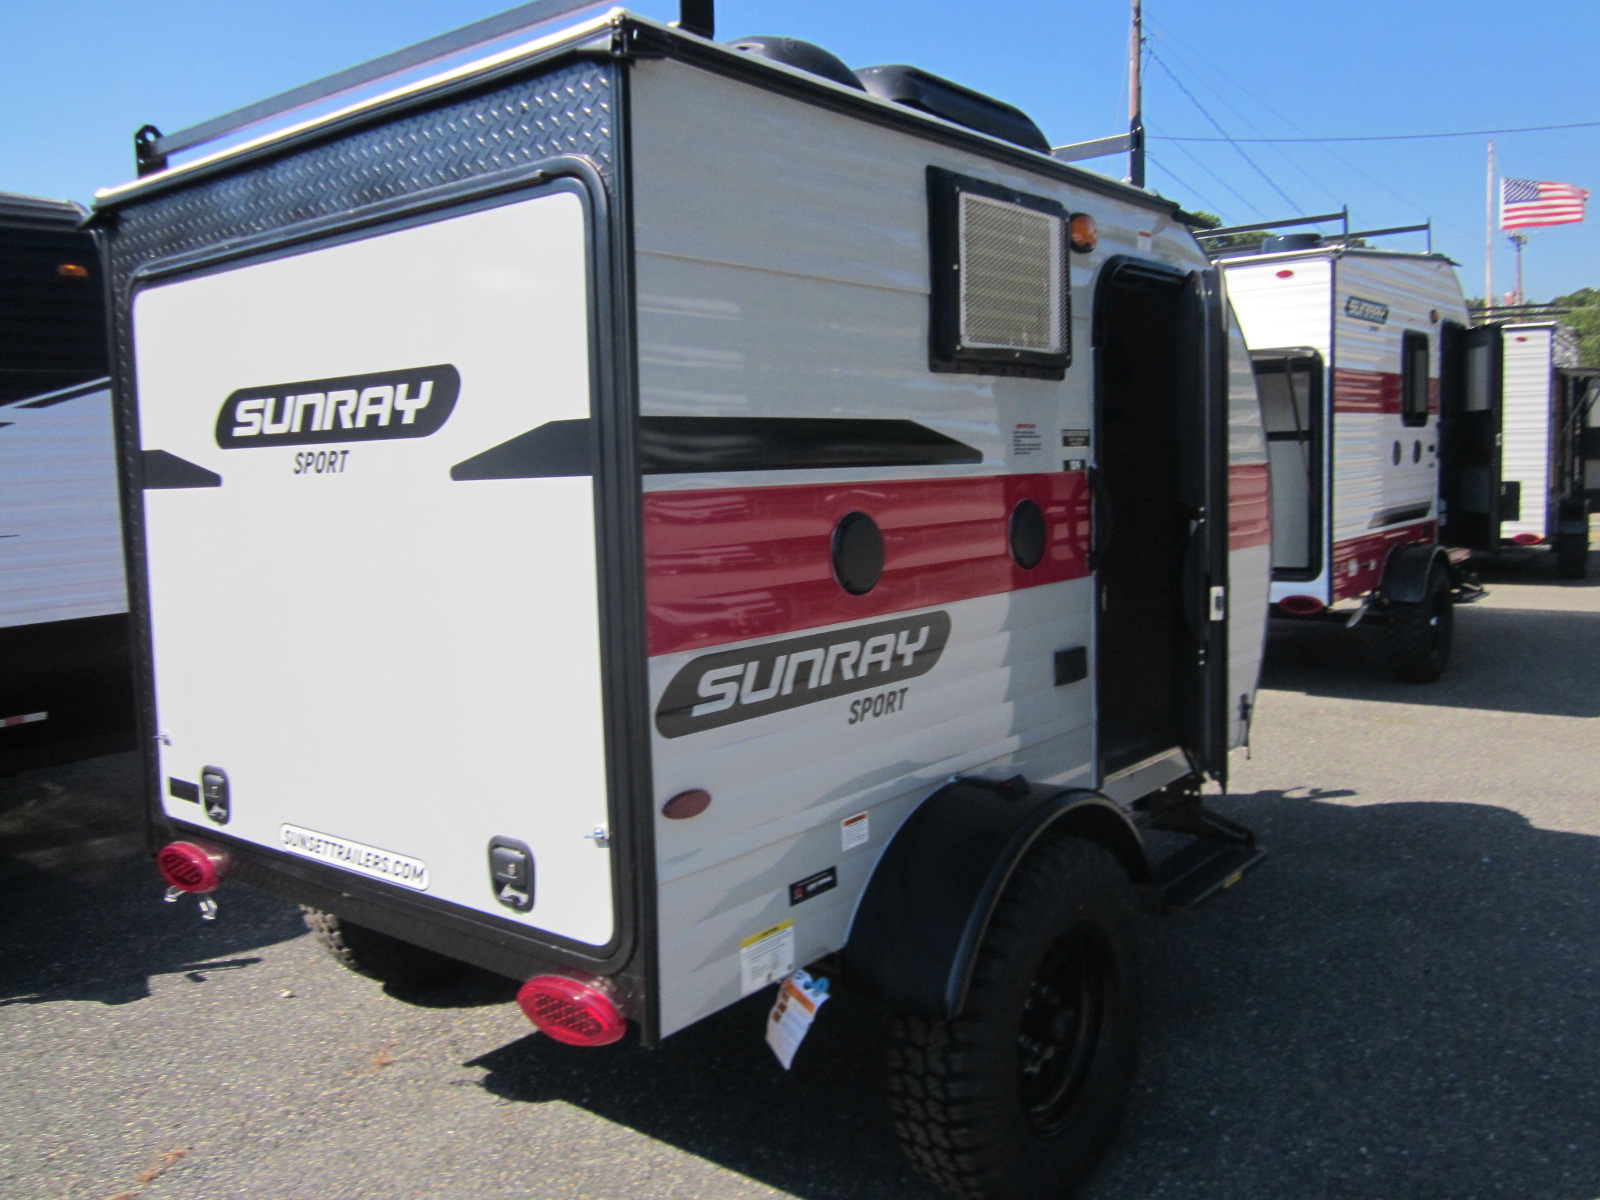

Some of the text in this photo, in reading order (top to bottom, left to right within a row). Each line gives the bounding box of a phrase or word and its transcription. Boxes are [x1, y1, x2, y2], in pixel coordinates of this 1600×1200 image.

[232, 380, 434, 437] SUNRAY
[293, 450, 350, 474] SPORT
[691, 626, 930, 718] SUNRAY
[847, 687, 909, 725] SPORT
[284, 830, 426, 884] SUNSETTRAILERS.COM
